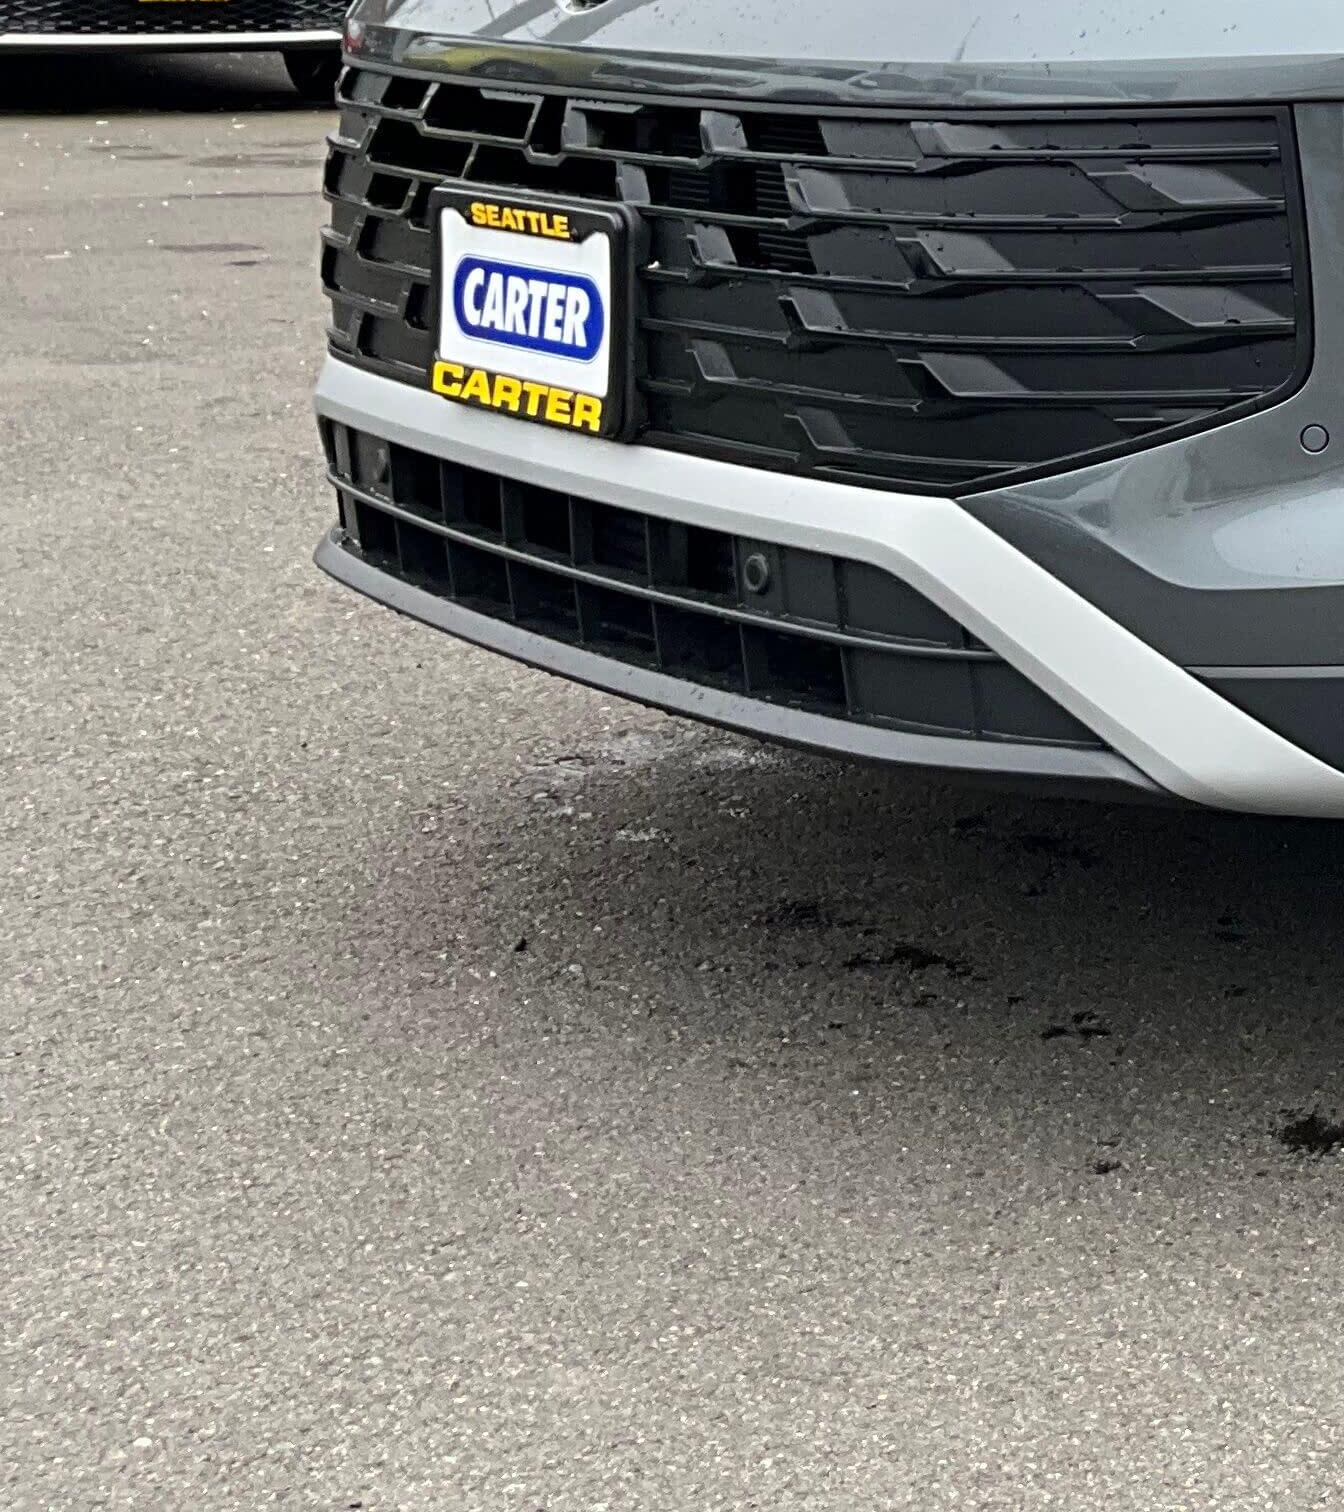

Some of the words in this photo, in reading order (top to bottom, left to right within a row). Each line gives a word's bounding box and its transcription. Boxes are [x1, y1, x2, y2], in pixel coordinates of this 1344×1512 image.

[470, 202, 570, 239] SEATTLE
[463, 267, 590, 348] CARTER
[432, 361, 602, 432] CARTER
